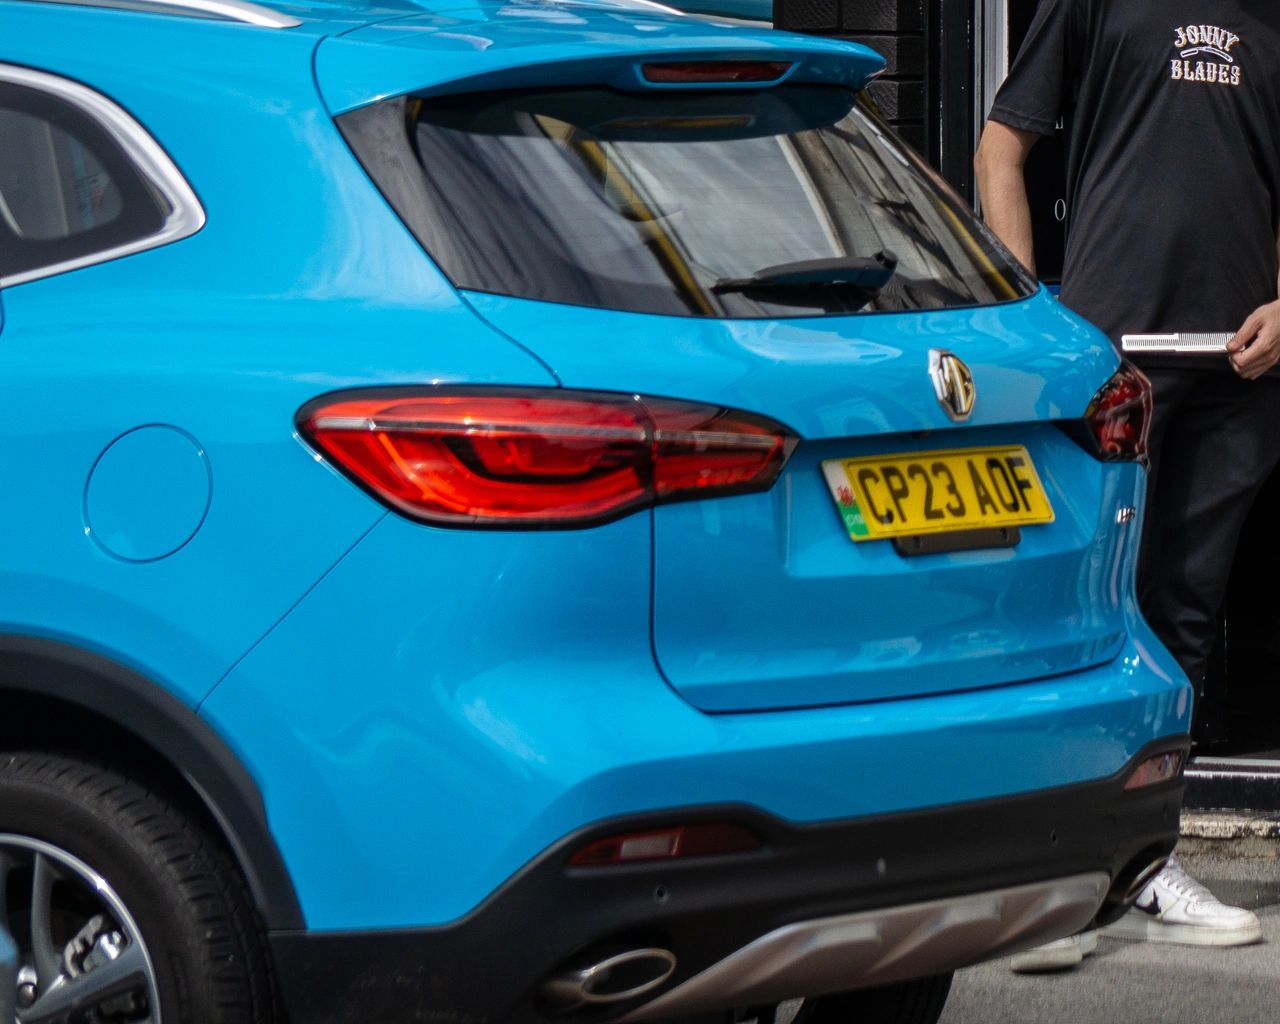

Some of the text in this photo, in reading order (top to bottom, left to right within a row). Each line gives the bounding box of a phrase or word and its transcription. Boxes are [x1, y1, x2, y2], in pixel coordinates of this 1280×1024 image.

[1174, 25, 1239, 51] JONNY
[1171, 59, 1240, 85] BLADES
[857, 456, 1033, 525] CP23 AOF
